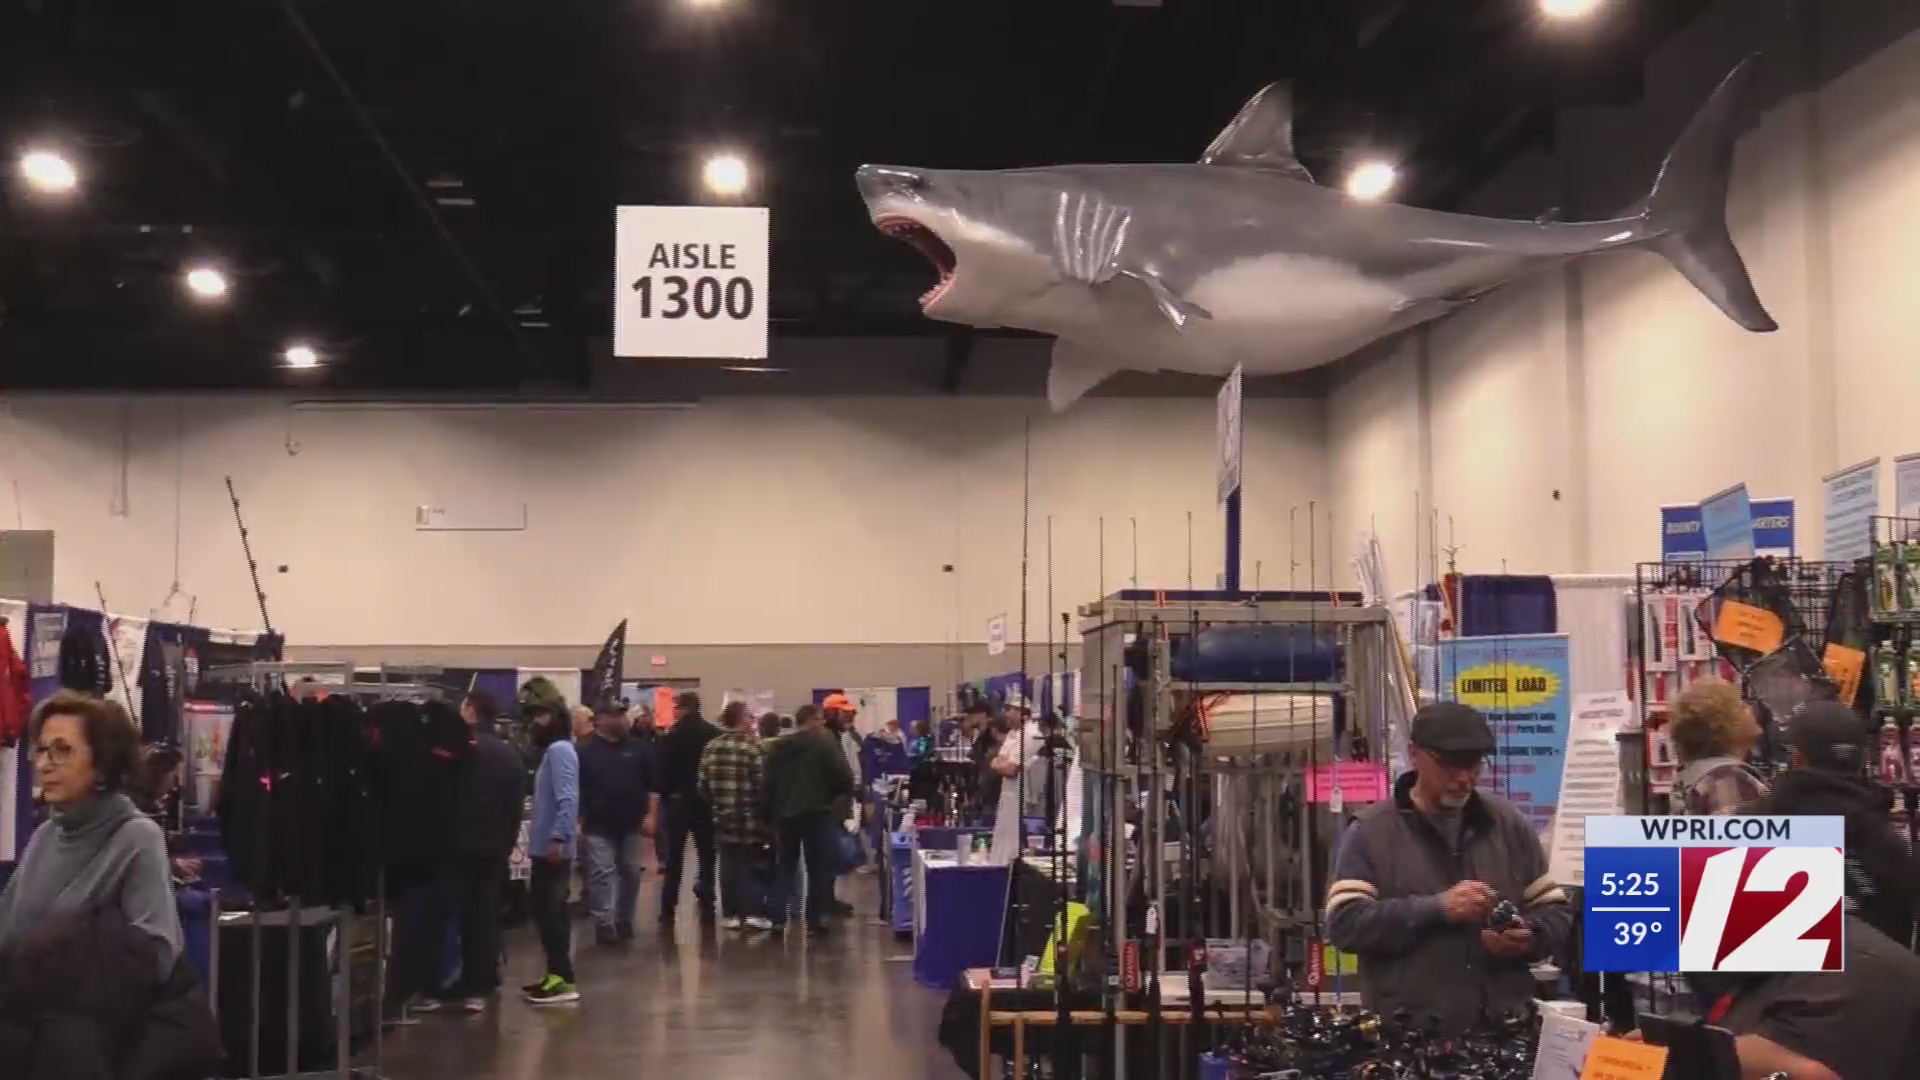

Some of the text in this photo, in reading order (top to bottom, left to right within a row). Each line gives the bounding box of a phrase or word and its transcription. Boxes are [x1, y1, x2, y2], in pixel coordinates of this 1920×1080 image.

[649, 243, 737, 269] AISLE
[632, 275, 754, 320] 1300
[1461, 677, 1547, 693] LIMITED LOAD
